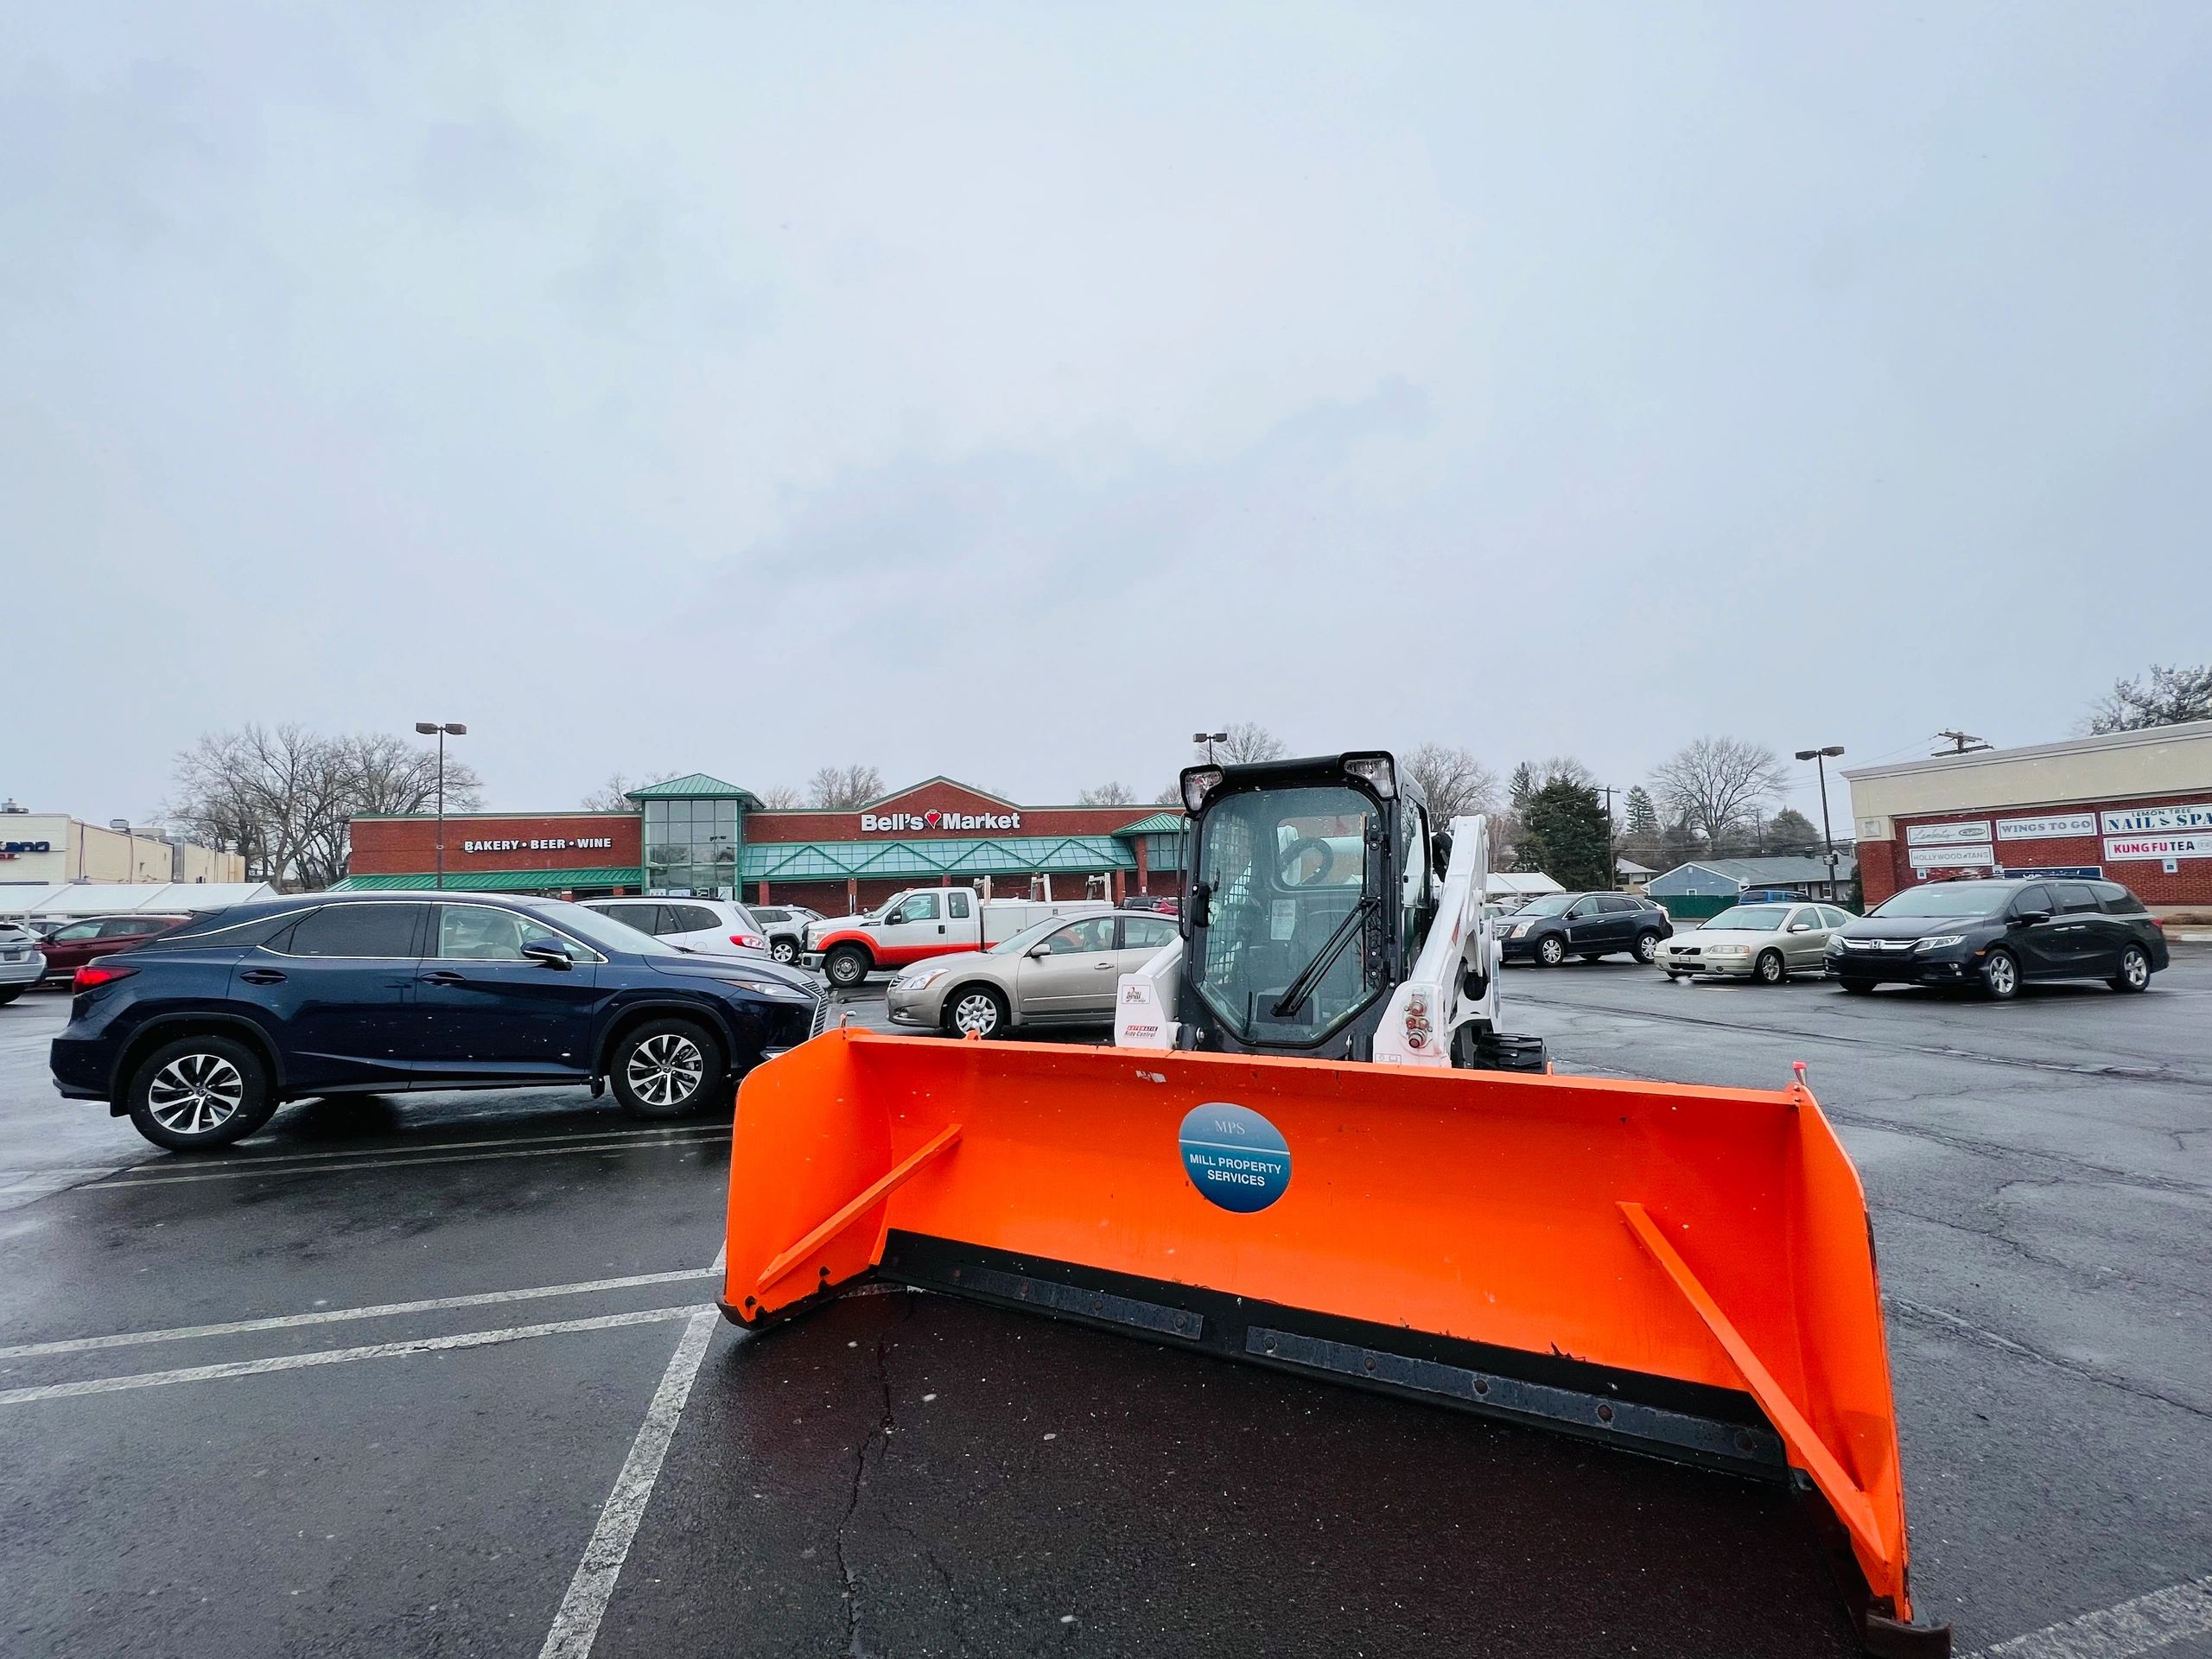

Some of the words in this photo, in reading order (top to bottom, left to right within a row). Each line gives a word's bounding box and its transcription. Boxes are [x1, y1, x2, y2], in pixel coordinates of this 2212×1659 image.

[2132, 809, 2164, 817] LEMON
[861, 813, 925, 831] Bell's
[942, 812, 1020, 830] Market
[2001, 823, 2045, 833] WINGS
[2049, 822, 2067, 830] TO
[2070, 820, 2091, 829] GO
[2108, 817, 2155, 830] NAIL
[2176, 812, 2212, 826] SPA
[464, 840, 519, 852] BAKERY
[530, 839, 566, 849] BEER
[577, 837, 612, 849] WINE
[2170, 841, 2196, 851] TEA
[1913, 853, 1962, 861] HOLLYWOOD
[1214, 1120, 1245, 1135] MPS
[1189, 1154, 1216, 1166] MILL
[1218, 1157, 1281, 1175] PROPERTY
[1207, 1169, 1266, 1187] SERVICES
